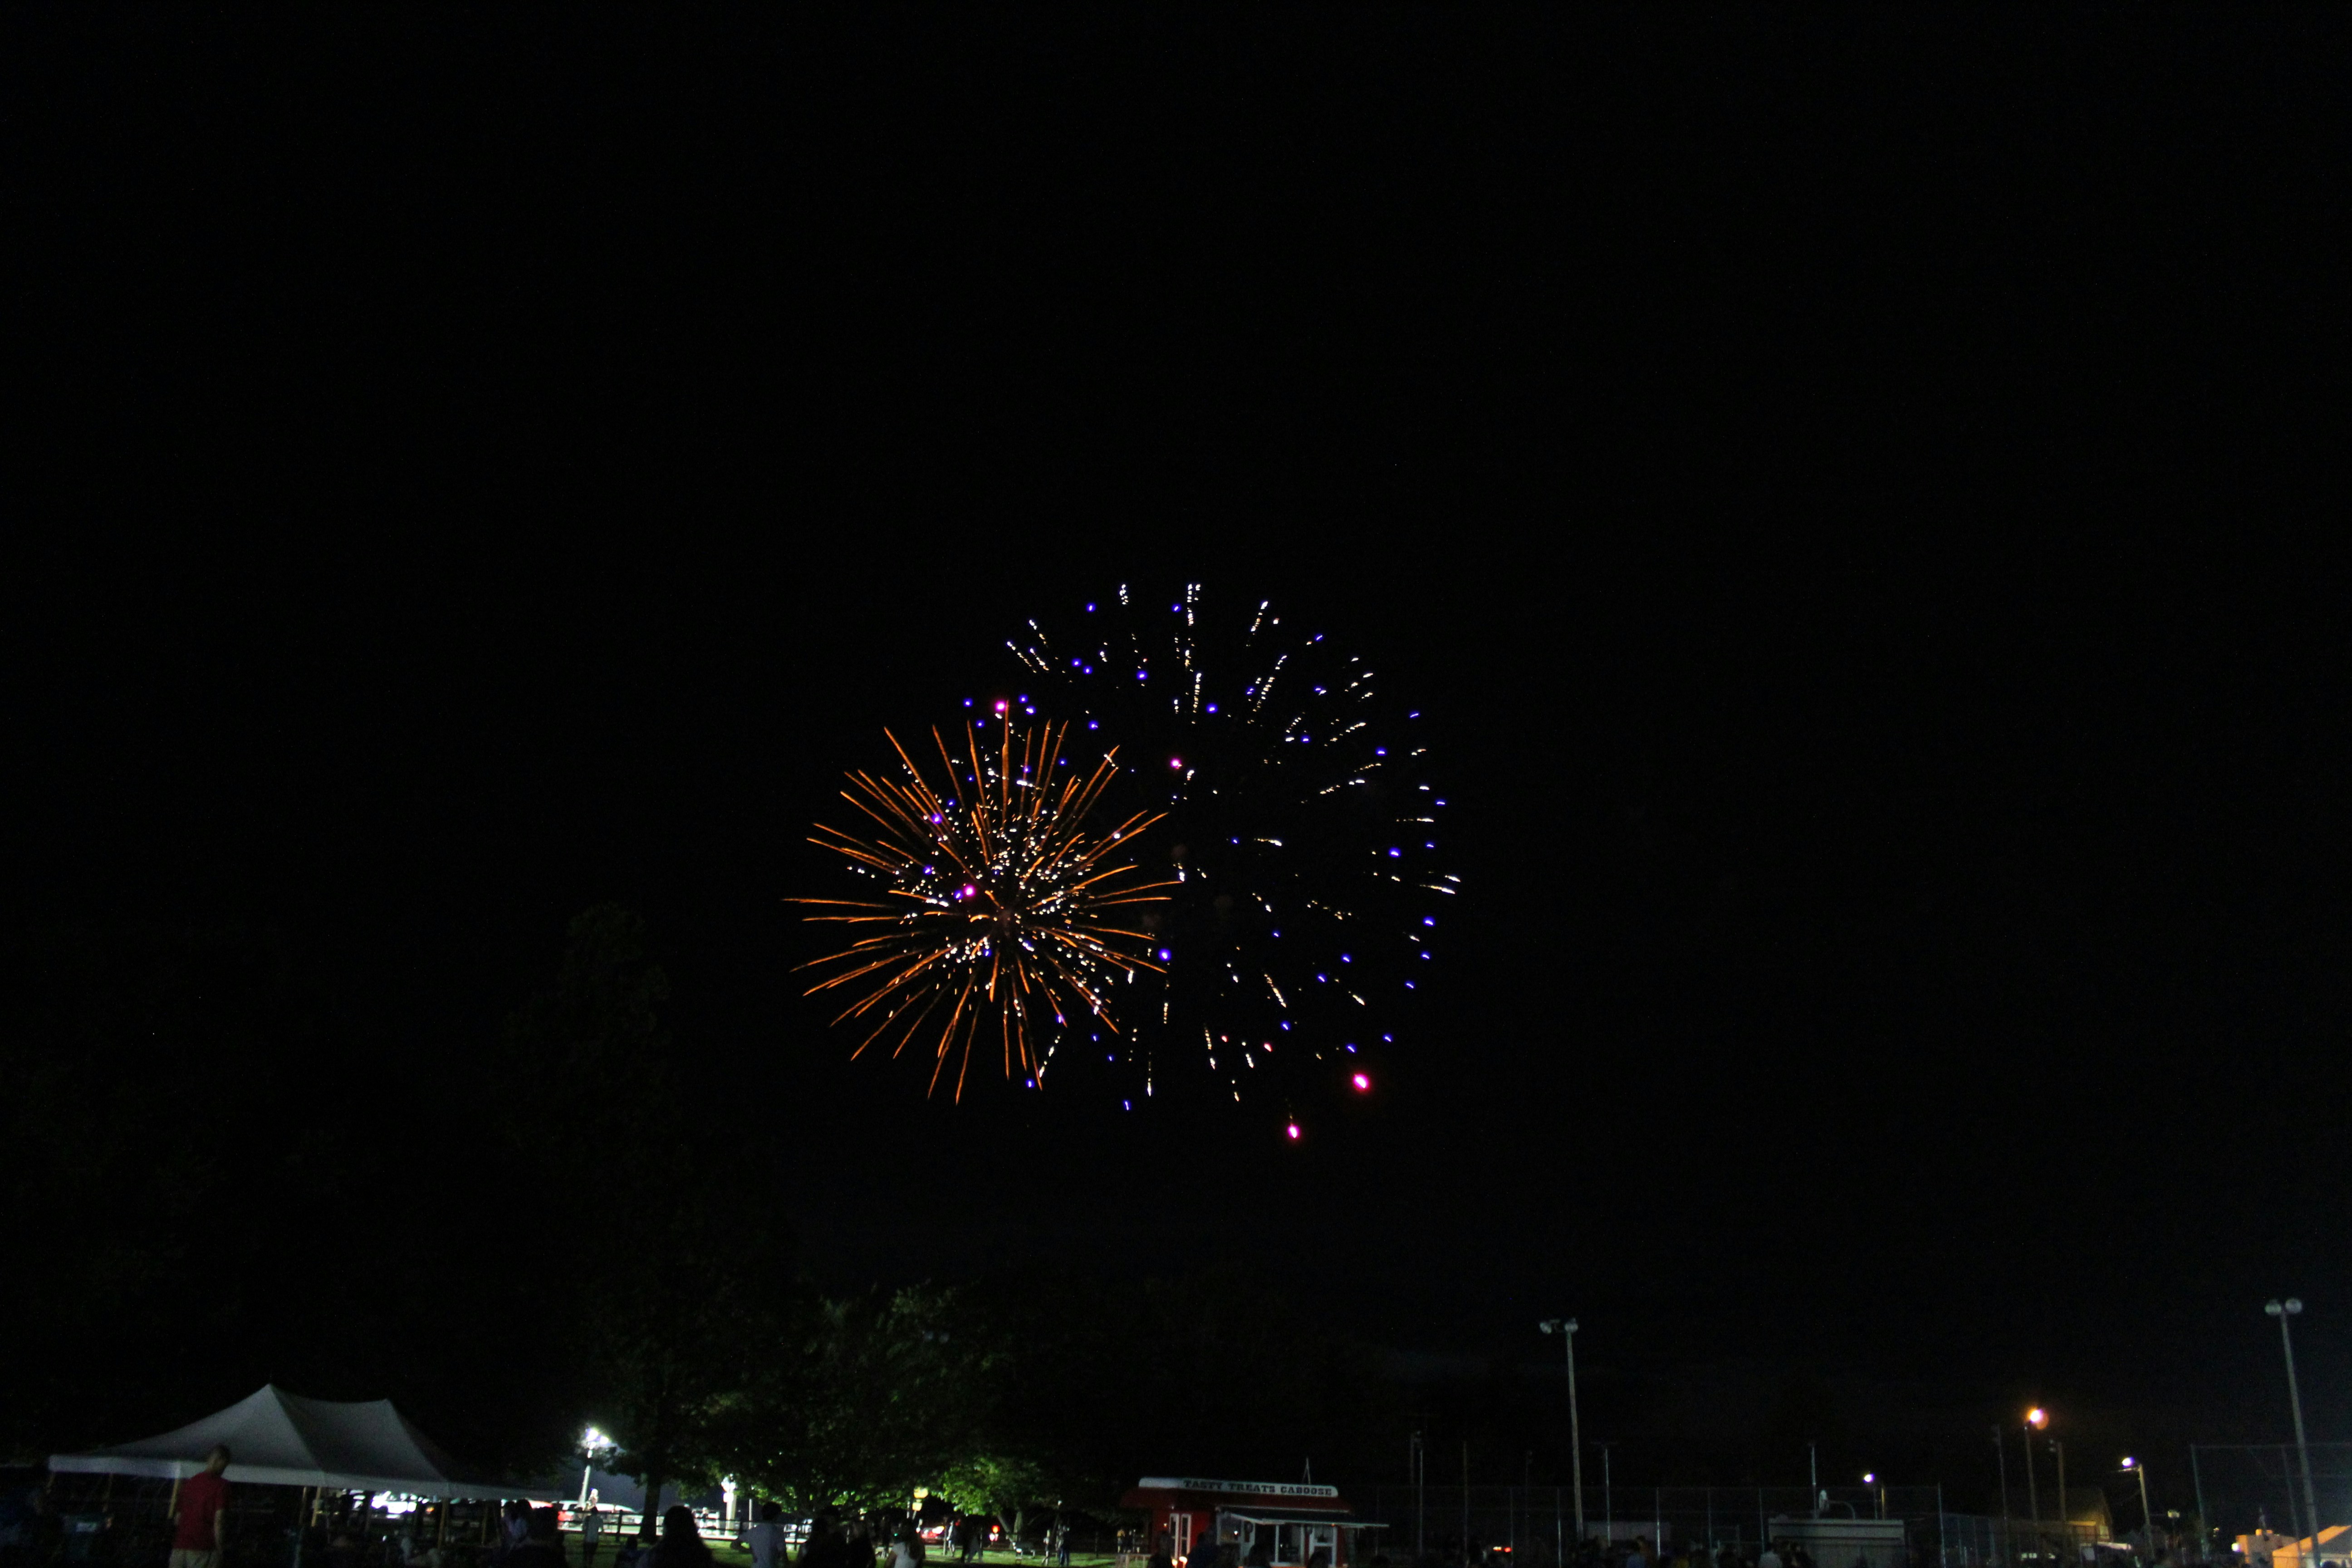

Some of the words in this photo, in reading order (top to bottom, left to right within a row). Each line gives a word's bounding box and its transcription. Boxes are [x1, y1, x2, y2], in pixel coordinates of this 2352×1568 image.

[1183, 1480, 1223, 1490] TASTY
[1229, 1483, 1275, 1493] TREATS
[1281, 1486, 1332, 1496] CABOOSE
